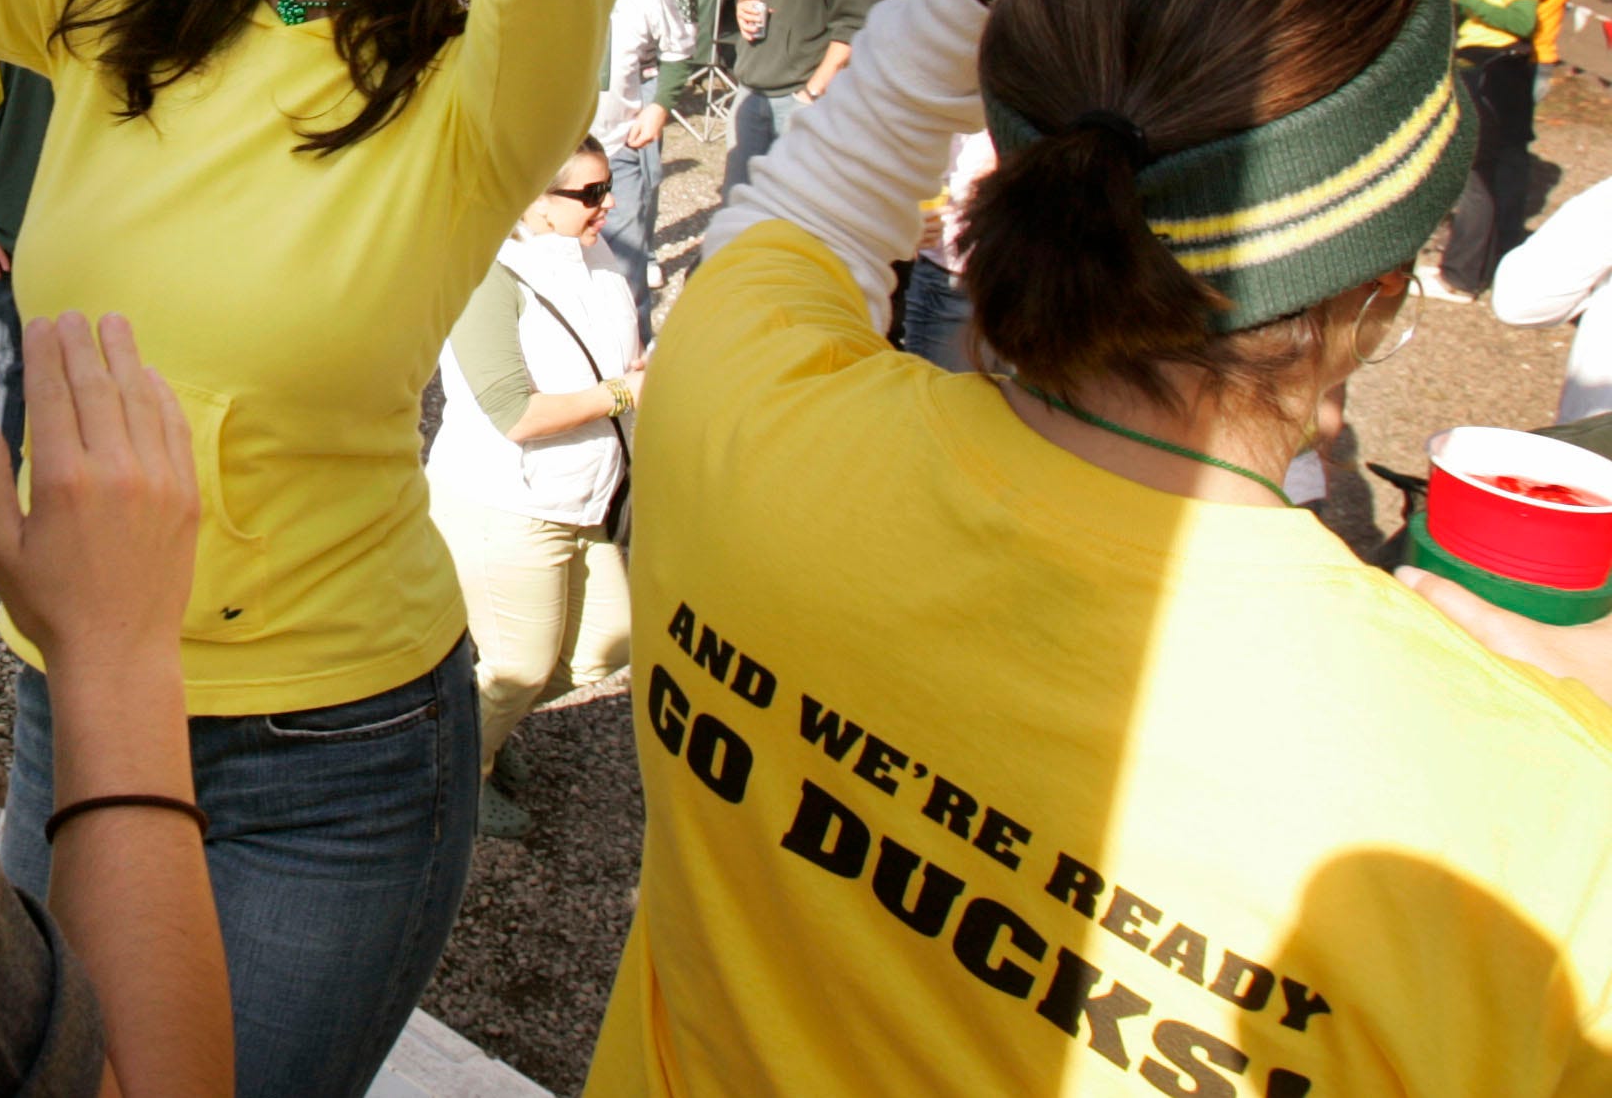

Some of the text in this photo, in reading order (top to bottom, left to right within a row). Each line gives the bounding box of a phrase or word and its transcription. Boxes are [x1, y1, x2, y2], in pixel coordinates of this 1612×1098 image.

[648, 663, 754, 805] GO
[666, 601, 1332, 1033] AND WE'RE READY
